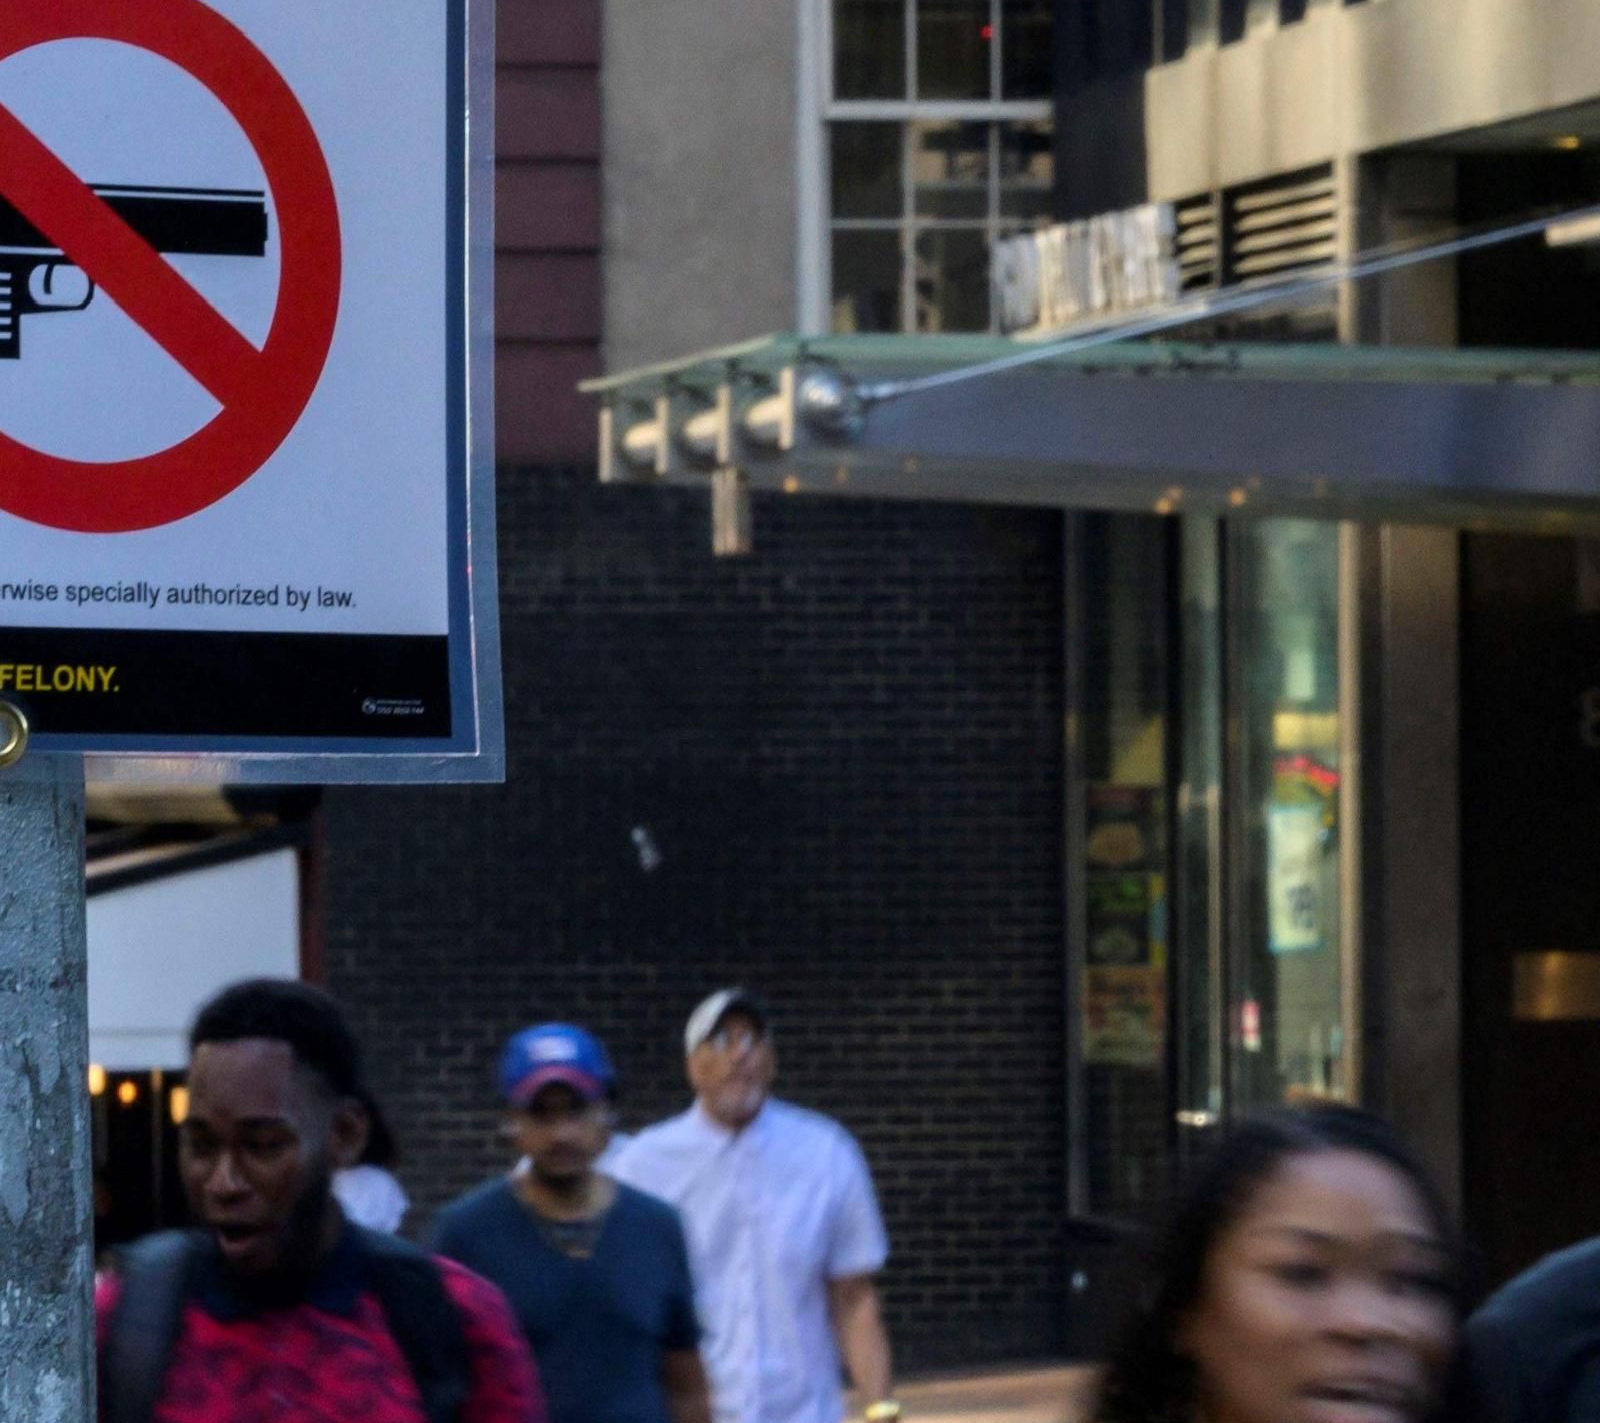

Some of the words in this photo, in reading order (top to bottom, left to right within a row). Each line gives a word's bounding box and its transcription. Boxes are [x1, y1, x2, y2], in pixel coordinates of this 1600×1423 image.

[65, 581, 161, 610] specially
[166, 582, 279, 607] authorized
[285, 585, 312, 613] by
[316, 585, 357, 608] law.
